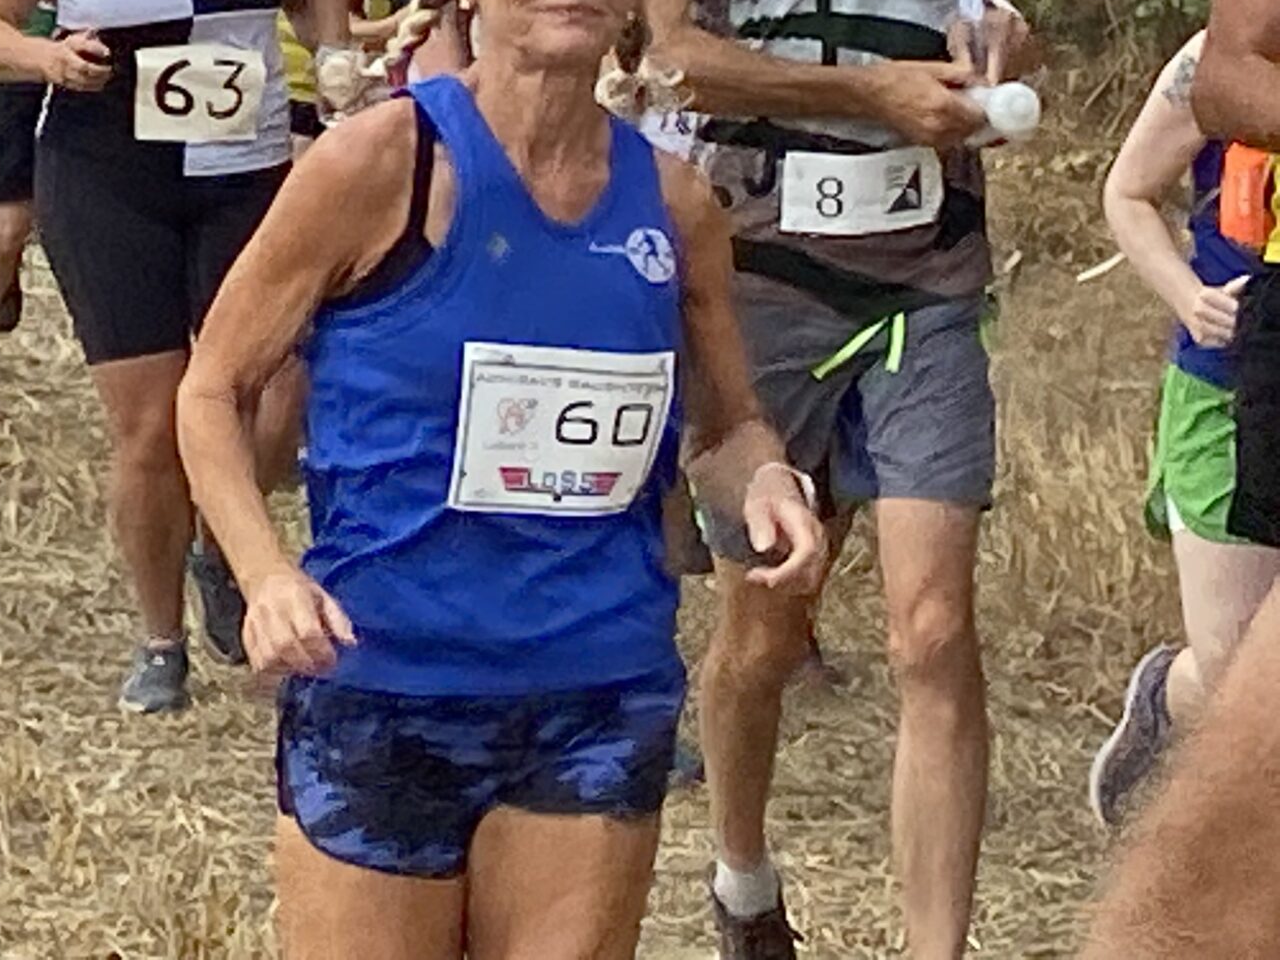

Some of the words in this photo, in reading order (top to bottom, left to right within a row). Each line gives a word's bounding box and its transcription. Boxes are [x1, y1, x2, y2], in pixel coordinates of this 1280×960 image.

[154, 58, 247, 121] 63
[816, 176, 844, 218] 8
[555, 400, 654, 447] 60
